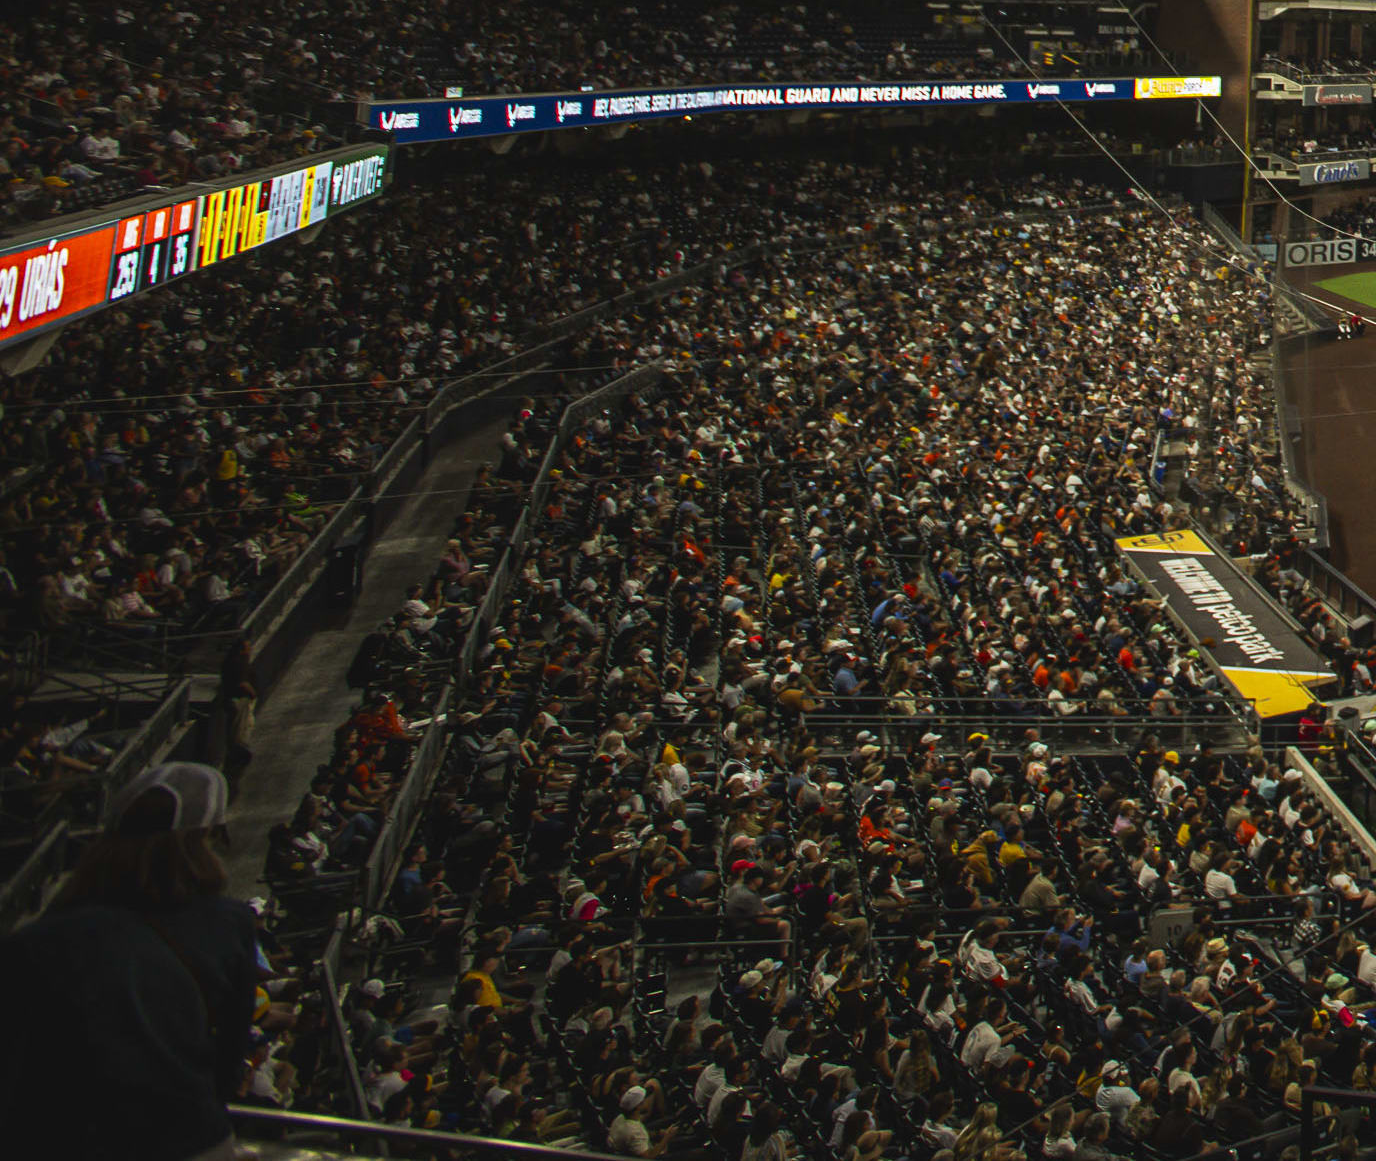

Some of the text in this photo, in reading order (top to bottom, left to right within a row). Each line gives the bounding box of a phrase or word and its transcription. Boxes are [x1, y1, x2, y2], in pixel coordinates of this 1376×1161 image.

[786, 88, 829, 103] GUARD
[831, 87, 859, 102] AND
[861, 87, 900, 102] NEVER
[901, 86, 931, 100] MISS
[932, 86, 940, 99] A
[941, 85, 973, 99] HOME
[974, 84, 1007, 98] GAME.
[1288, 241, 1355, 265] ORIS
[19, 239, 69, 321] URÍAS
[1196, 602, 1257, 635] petco
[1223, 633, 1285, 664] park
